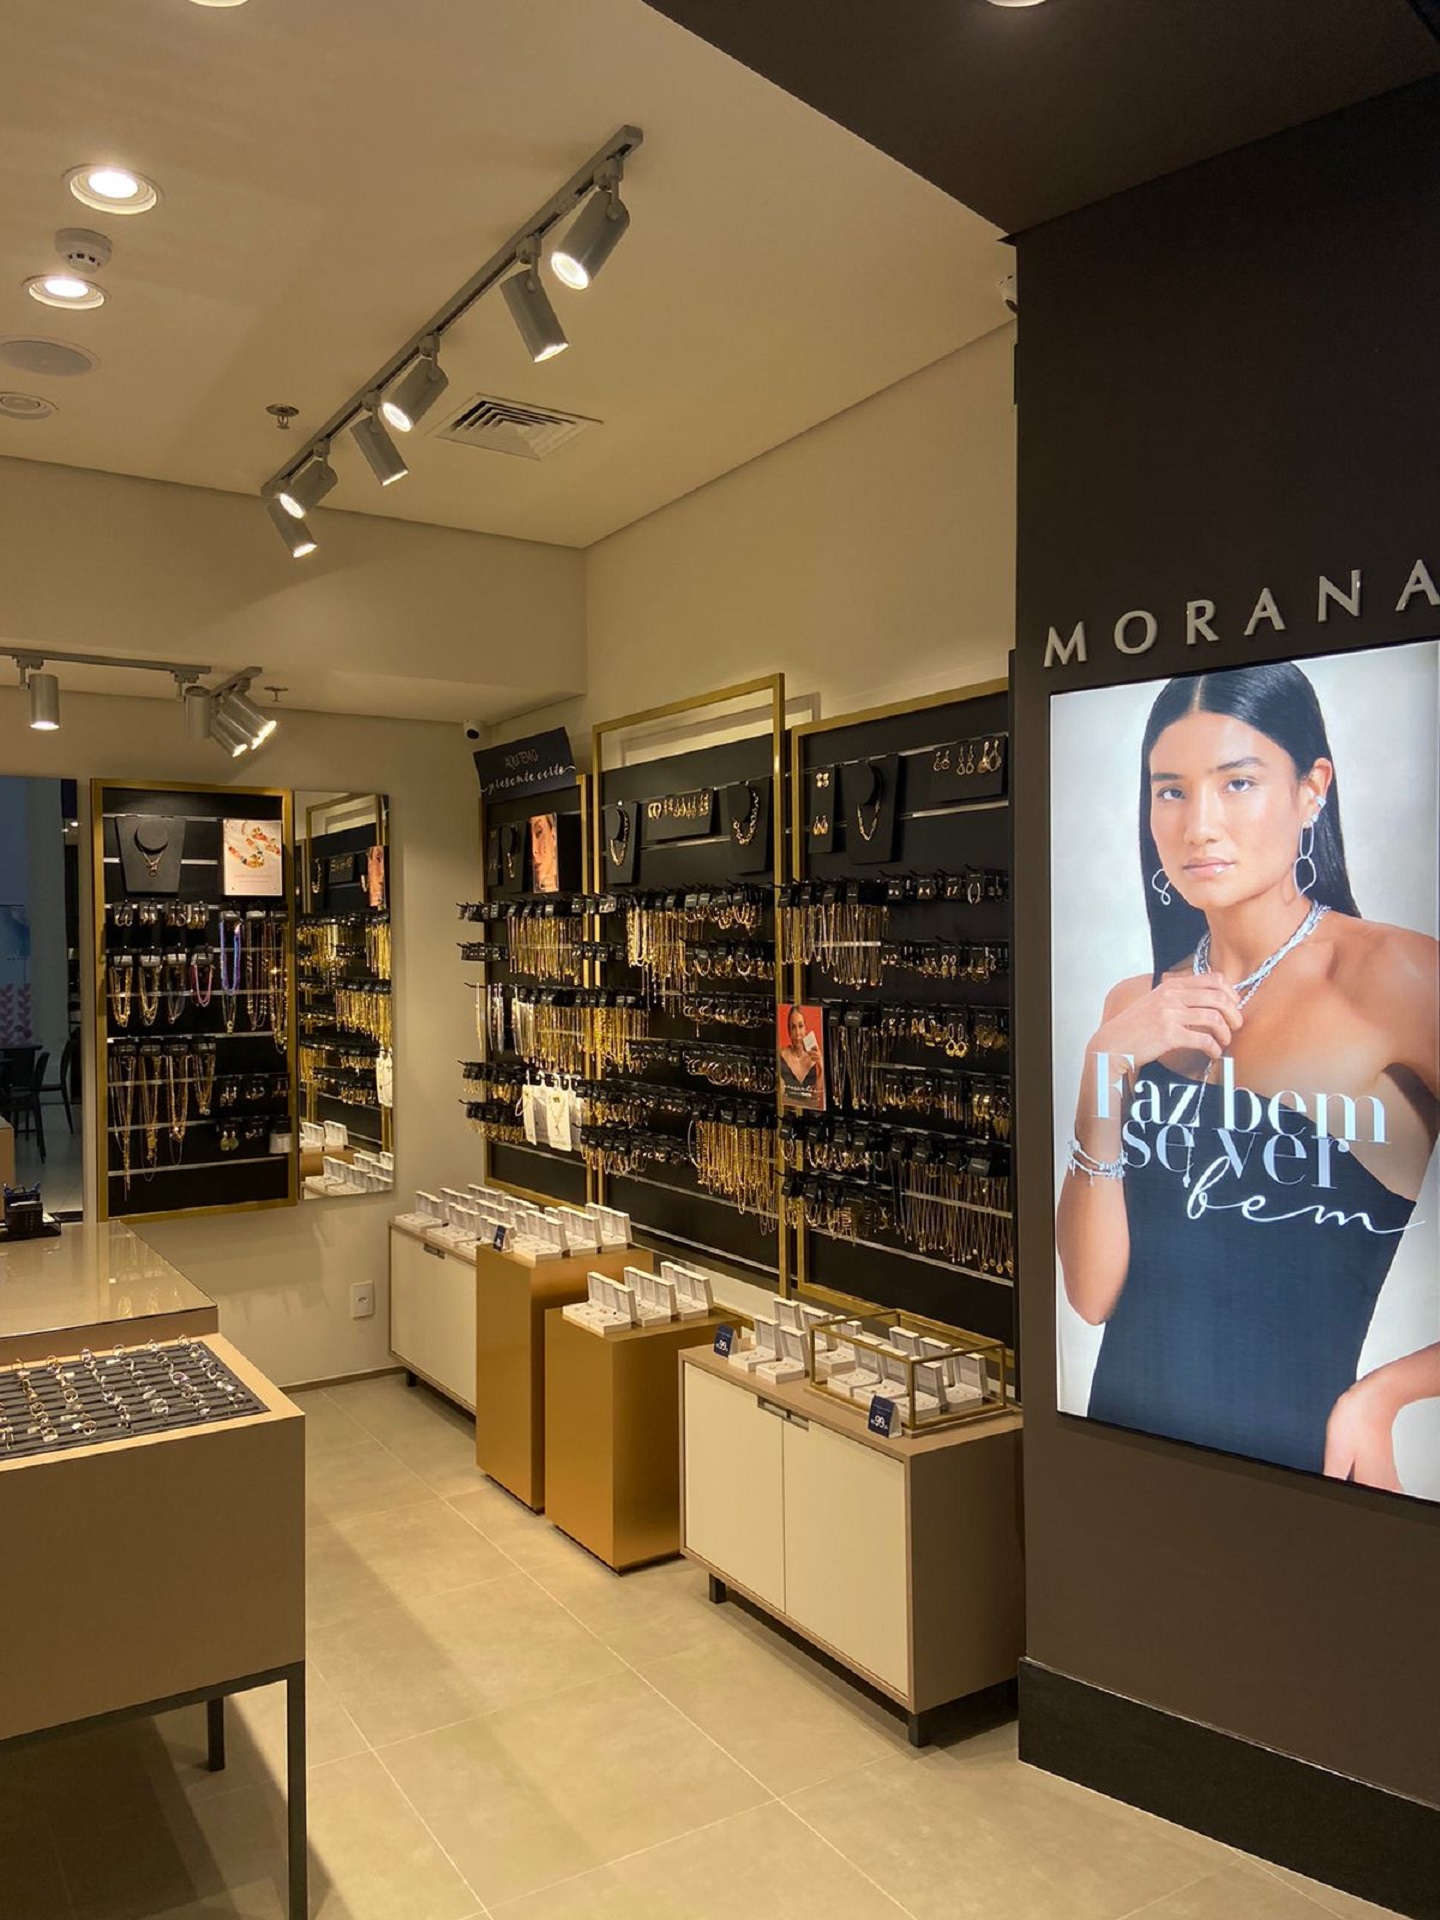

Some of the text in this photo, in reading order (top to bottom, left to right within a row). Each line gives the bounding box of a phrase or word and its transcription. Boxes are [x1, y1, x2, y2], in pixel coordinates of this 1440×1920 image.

[1043, 558, 1440, 668] MORANA
[1090, 1052, 1391, 1144] Faz bem
[1122, 1119, 1350, 1189] se ver
[1187, 1156, 1427, 1235] bem
